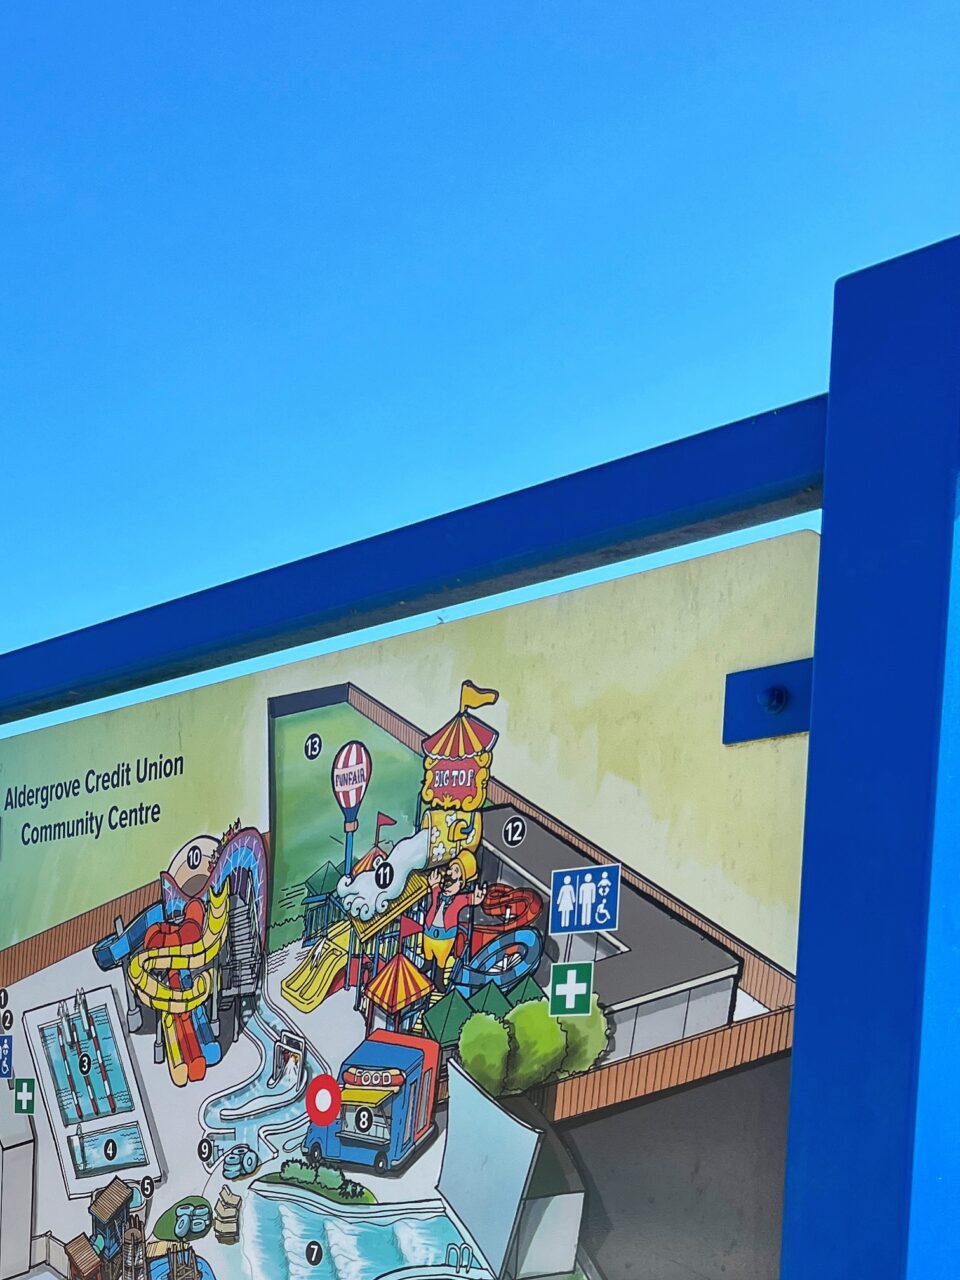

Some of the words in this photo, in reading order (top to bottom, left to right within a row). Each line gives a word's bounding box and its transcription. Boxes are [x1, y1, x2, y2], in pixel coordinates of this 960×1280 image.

[305, 737, 320, 757] 13
[3, 777, 81, 812] Aldergrove
[85, 764, 132, 795] Credit
[136, 753, 185, 783] Union
[452, 768, 475, 788] TOP
[21, 811, 104, 847] Community
[108, 802, 161, 829] Centre
[505, 821, 523, 842] 12
[355, 1069, 392, 1086] FOOD
